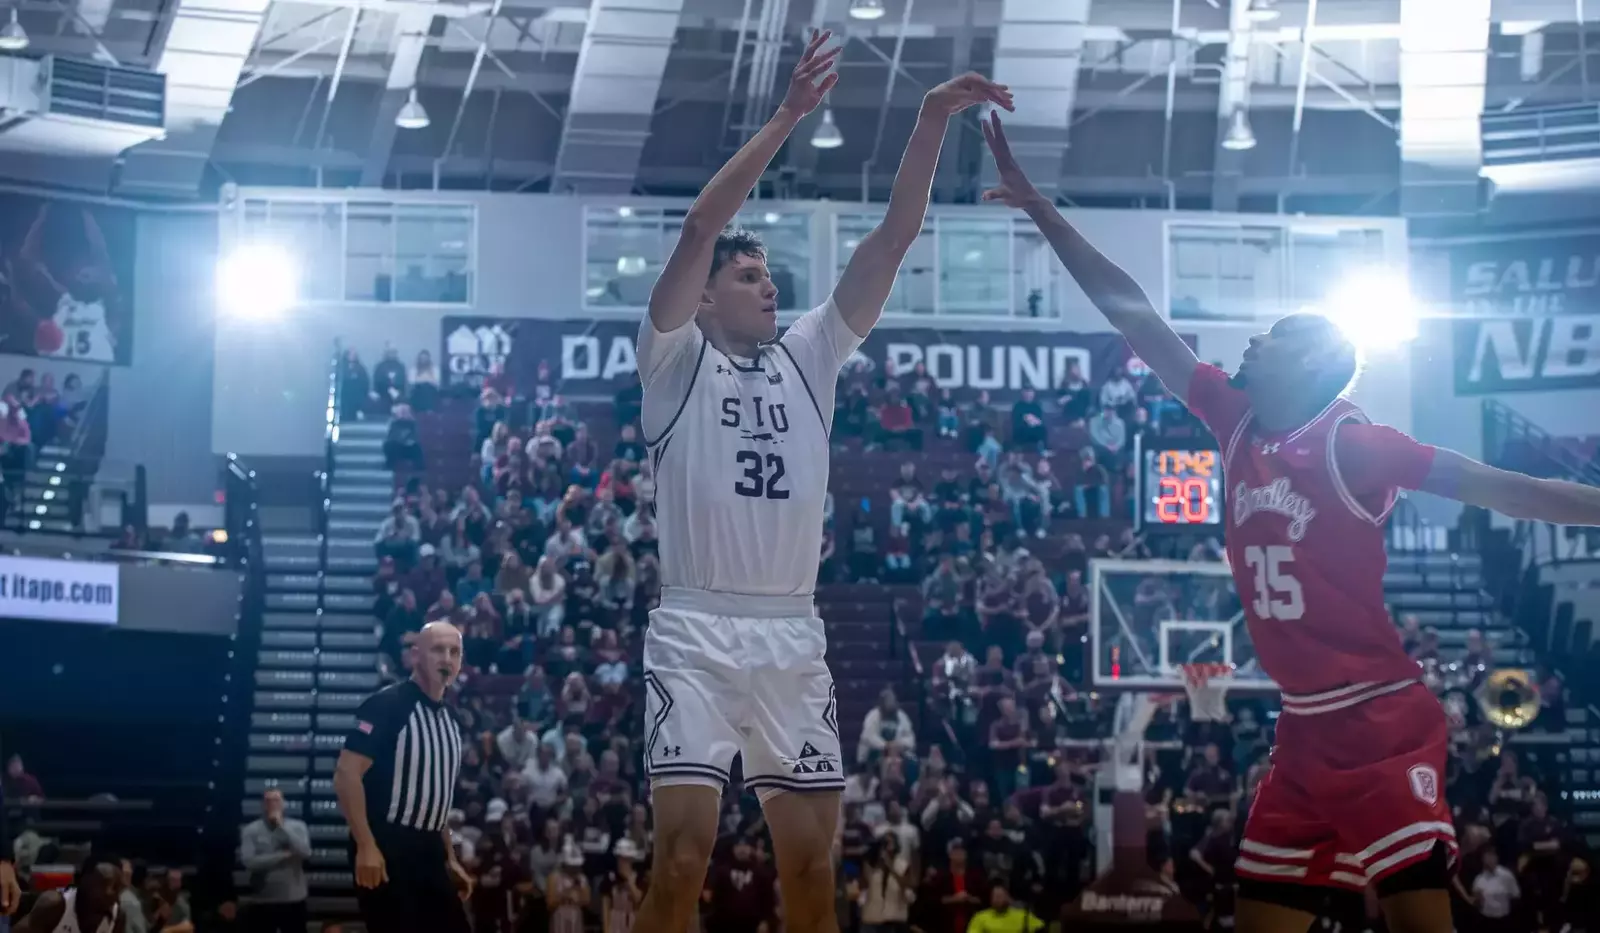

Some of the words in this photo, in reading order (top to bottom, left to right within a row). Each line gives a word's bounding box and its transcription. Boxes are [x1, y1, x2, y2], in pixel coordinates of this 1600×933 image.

[886, 342, 1092, 390] POUND
[1467, 317, 1600, 383] NB
[720, 396, 790, 434] SIU
[734, 450, 791, 500] 32
[1157, 476, 1209, 524] 20
[12, 573, 113, 605] itape.com
[1244, 545, 1306, 621] 35
